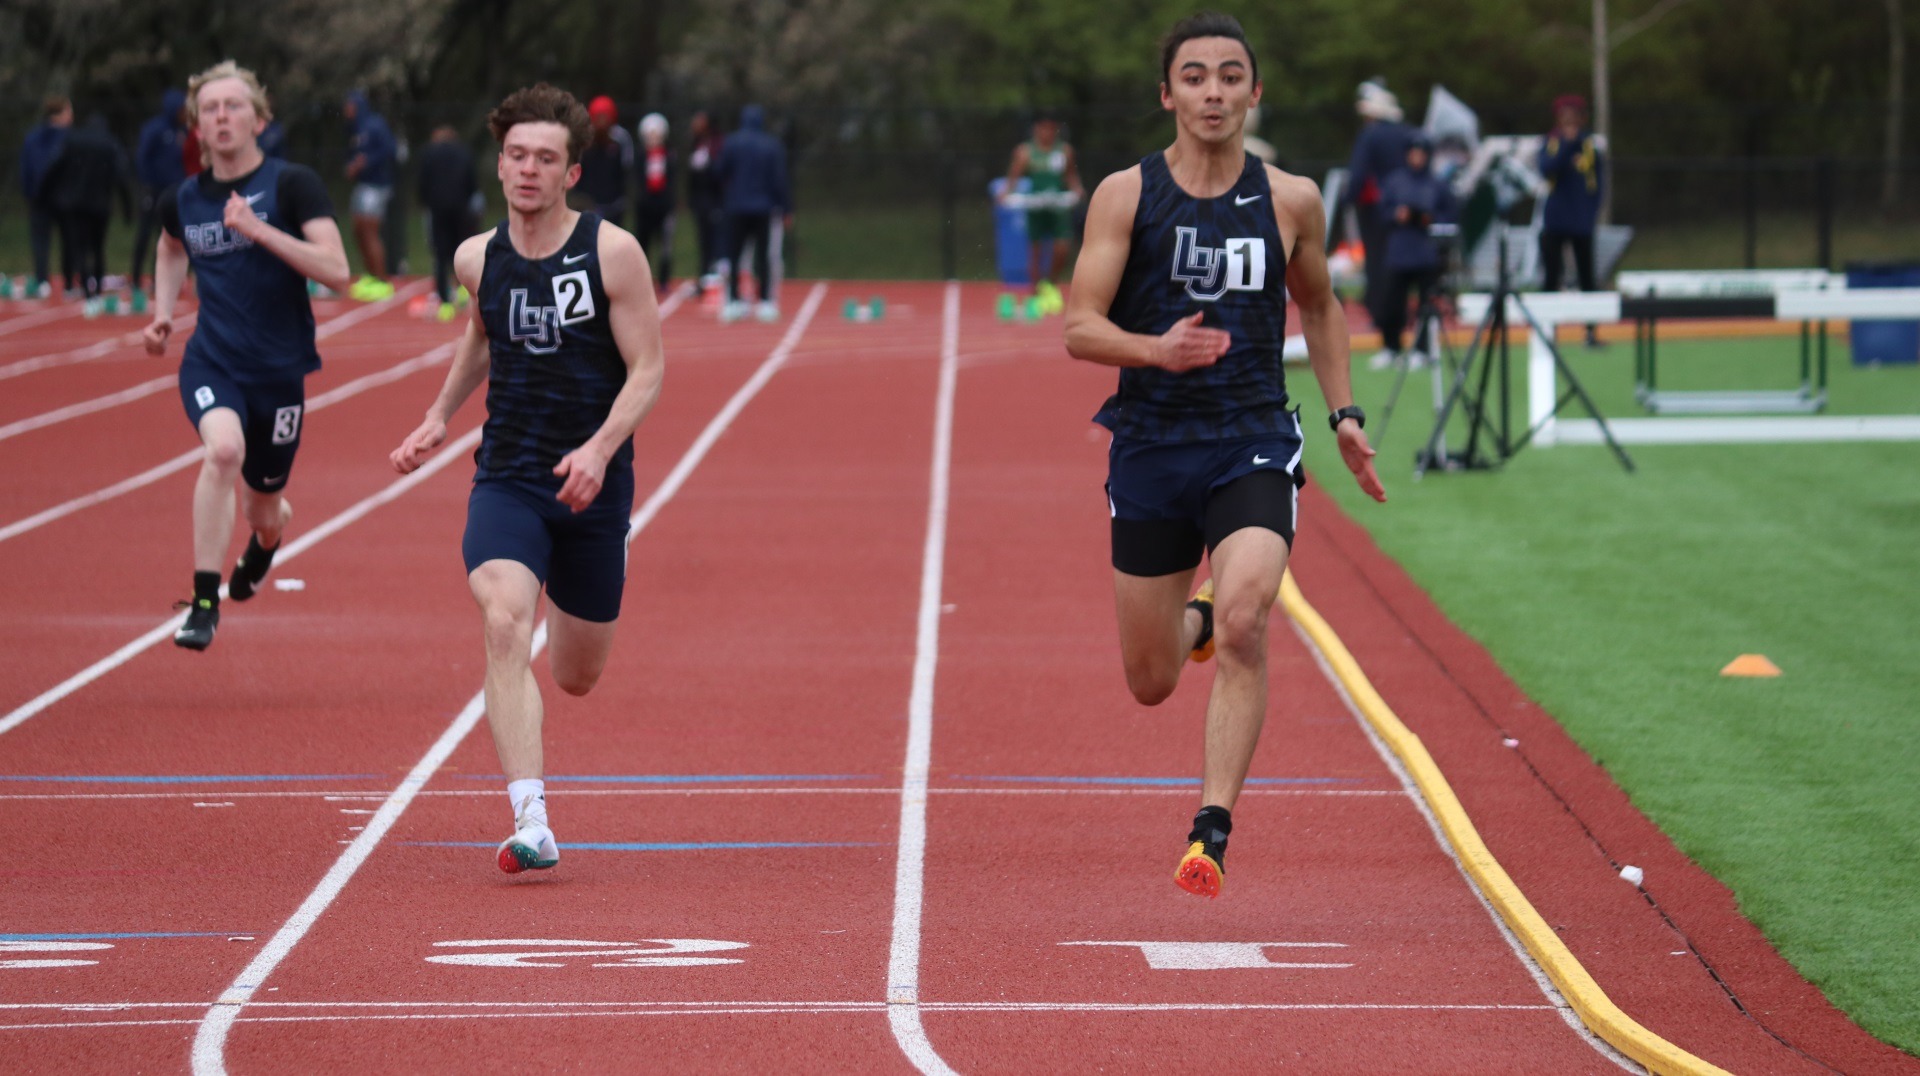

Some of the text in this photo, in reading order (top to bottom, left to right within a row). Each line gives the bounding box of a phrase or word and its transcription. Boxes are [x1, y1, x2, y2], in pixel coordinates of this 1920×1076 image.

[1233, 242, 1251, 286] 1
[509, 288, 562, 353] LU
[558, 277, 590, 321] 2
[278, 408, 295, 439] 3
